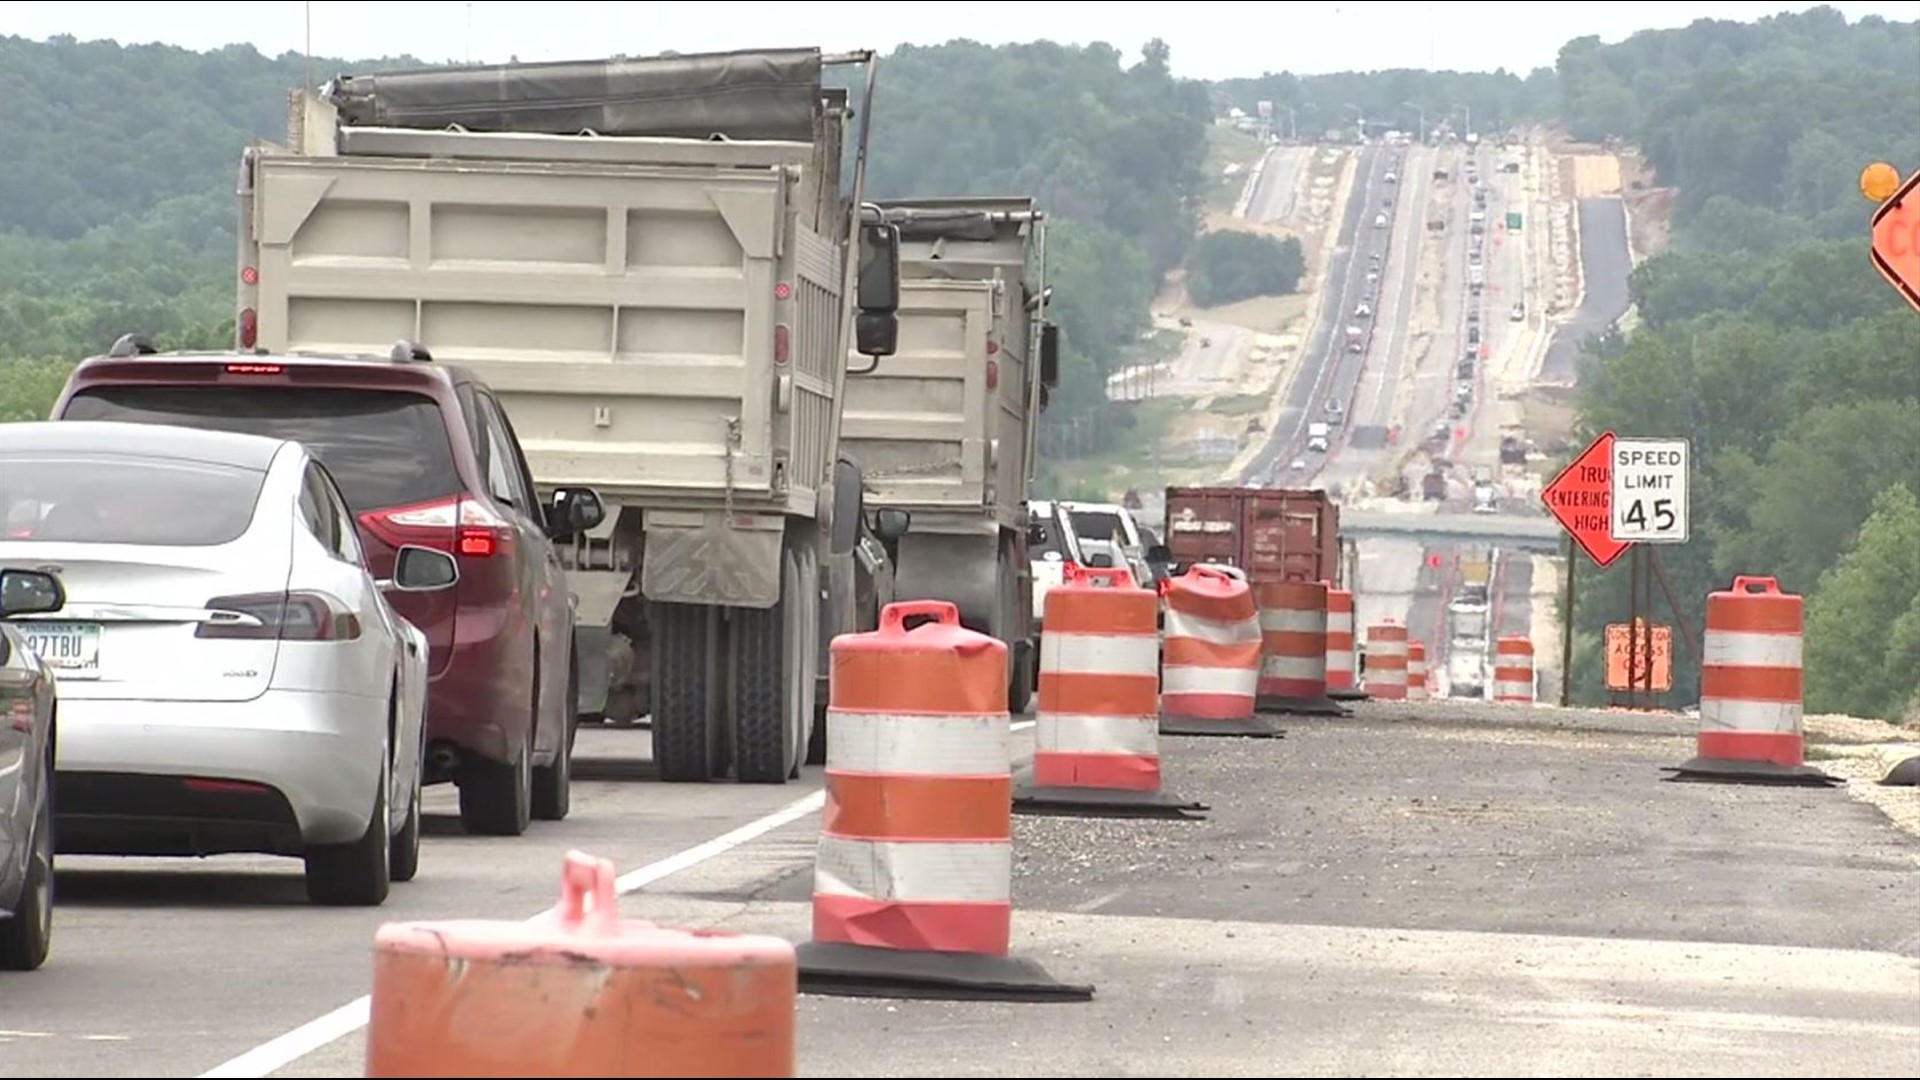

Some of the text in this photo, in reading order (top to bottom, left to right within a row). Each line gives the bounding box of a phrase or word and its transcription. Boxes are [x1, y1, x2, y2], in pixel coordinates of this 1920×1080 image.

[1618, 451, 1681, 466] SPEED
[1580, 466, 1611, 483] TRU
[1624, 475, 1673, 489] LIMIT
[1551, 490, 1610, 507] ENTERING
[1624, 499, 1675, 531] 45
